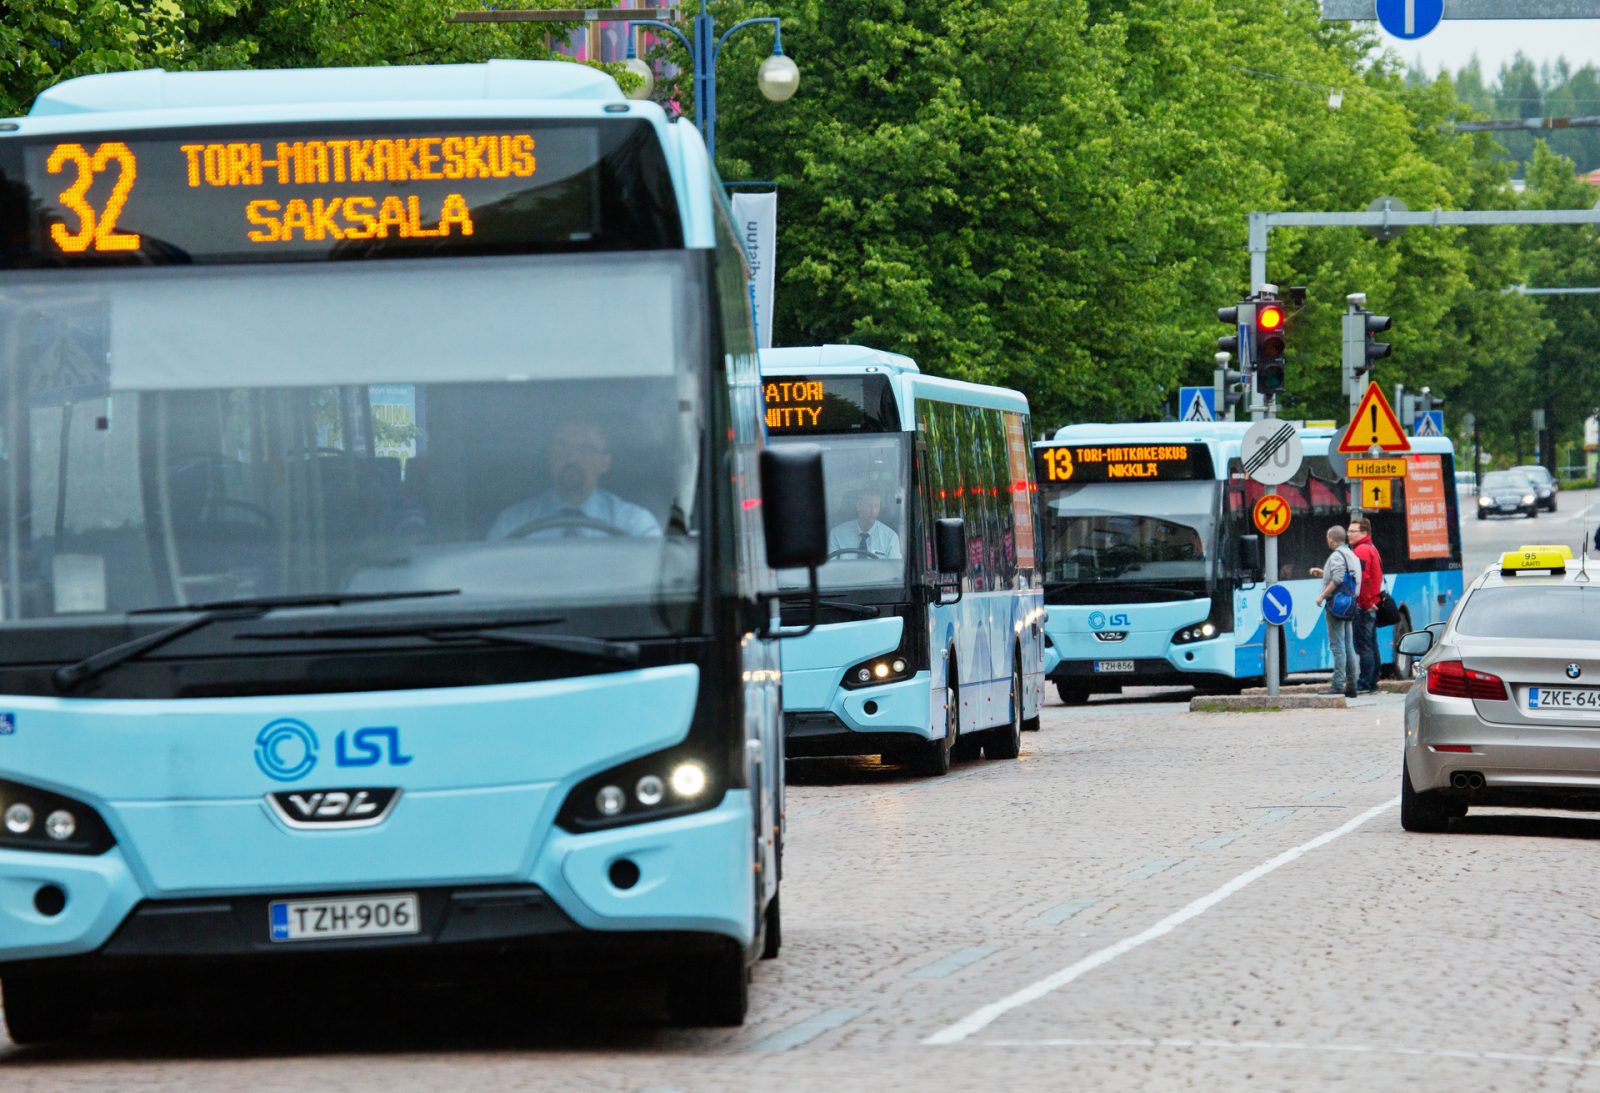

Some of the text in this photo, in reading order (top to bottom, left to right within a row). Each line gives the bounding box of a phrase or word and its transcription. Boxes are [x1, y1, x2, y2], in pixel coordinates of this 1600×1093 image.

[180, 134, 536, 188] TORI-MATKAKESKUS
[47, 142, 140, 252] 32
[246, 193, 474, 243] SAKSALA
[762, 381, 823, 402] ATORI
[1043, 448, 1073, 480] 13
[1076, 446, 1188, 462] TORI-MATKAKESKUS
[1108, 463, 1158, 478] NIKKILÄ
[1356, 463, 1397, 474] Hidaste
[1110, 614, 1131, 626] LSL
[335, 726, 413, 768] LSL
[288, 791, 378, 816] VDL
[293, 902, 410, 933] TZH-906
